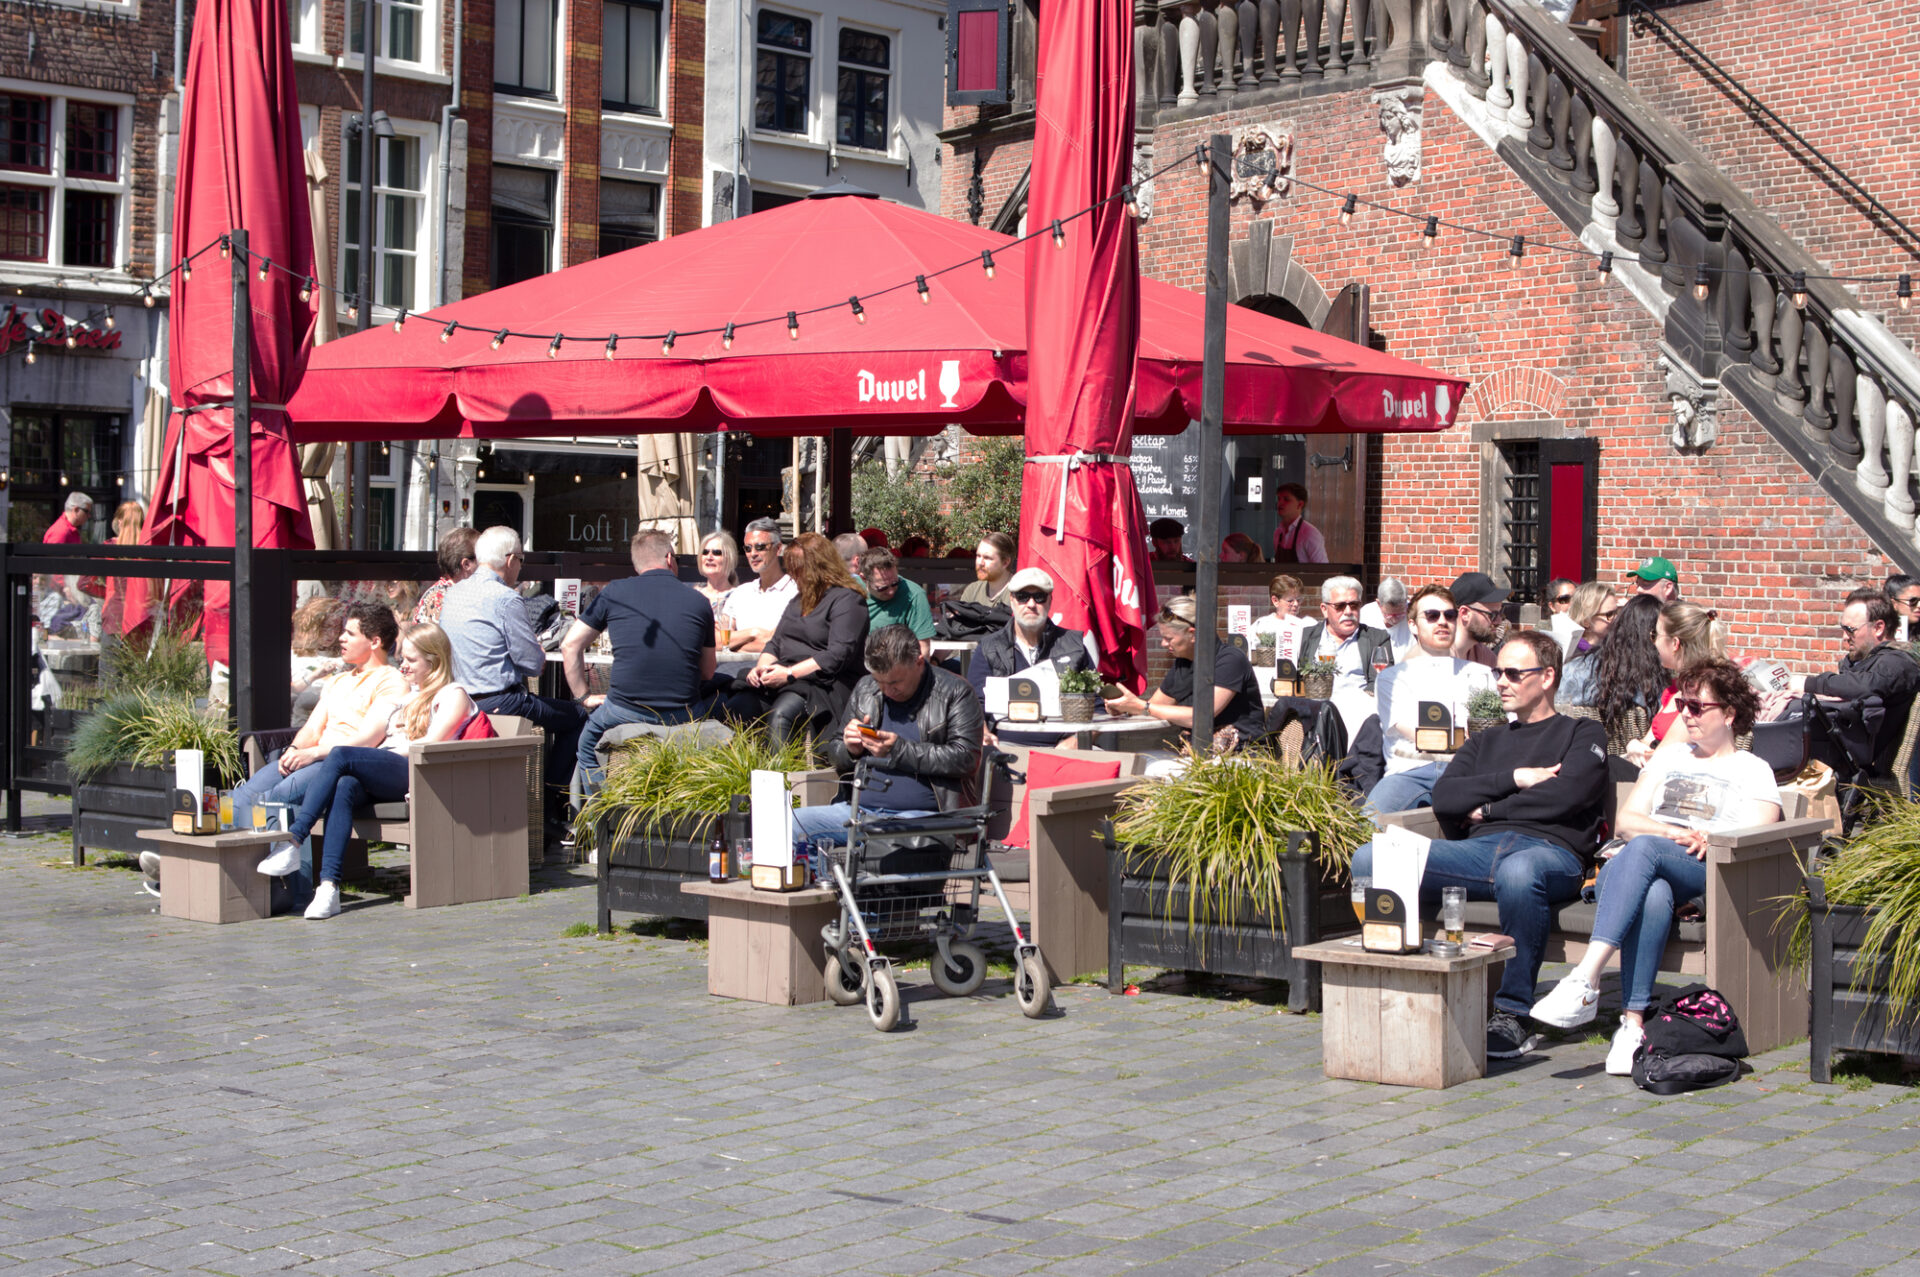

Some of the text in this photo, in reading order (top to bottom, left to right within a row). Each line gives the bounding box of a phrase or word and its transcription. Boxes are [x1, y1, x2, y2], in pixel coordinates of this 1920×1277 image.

[857, 369, 926, 402] Duvel
[1382, 389, 1428, 419] Duvel
[1161, 504, 1188, 517] Moment
[568, 514, 613, 542] Loft
[568, 585, 577, 597] DE
[1237, 610, 1246, 623] DE
[1283, 631, 1293, 644] DE
[1772, 667, 1790, 682] DE
